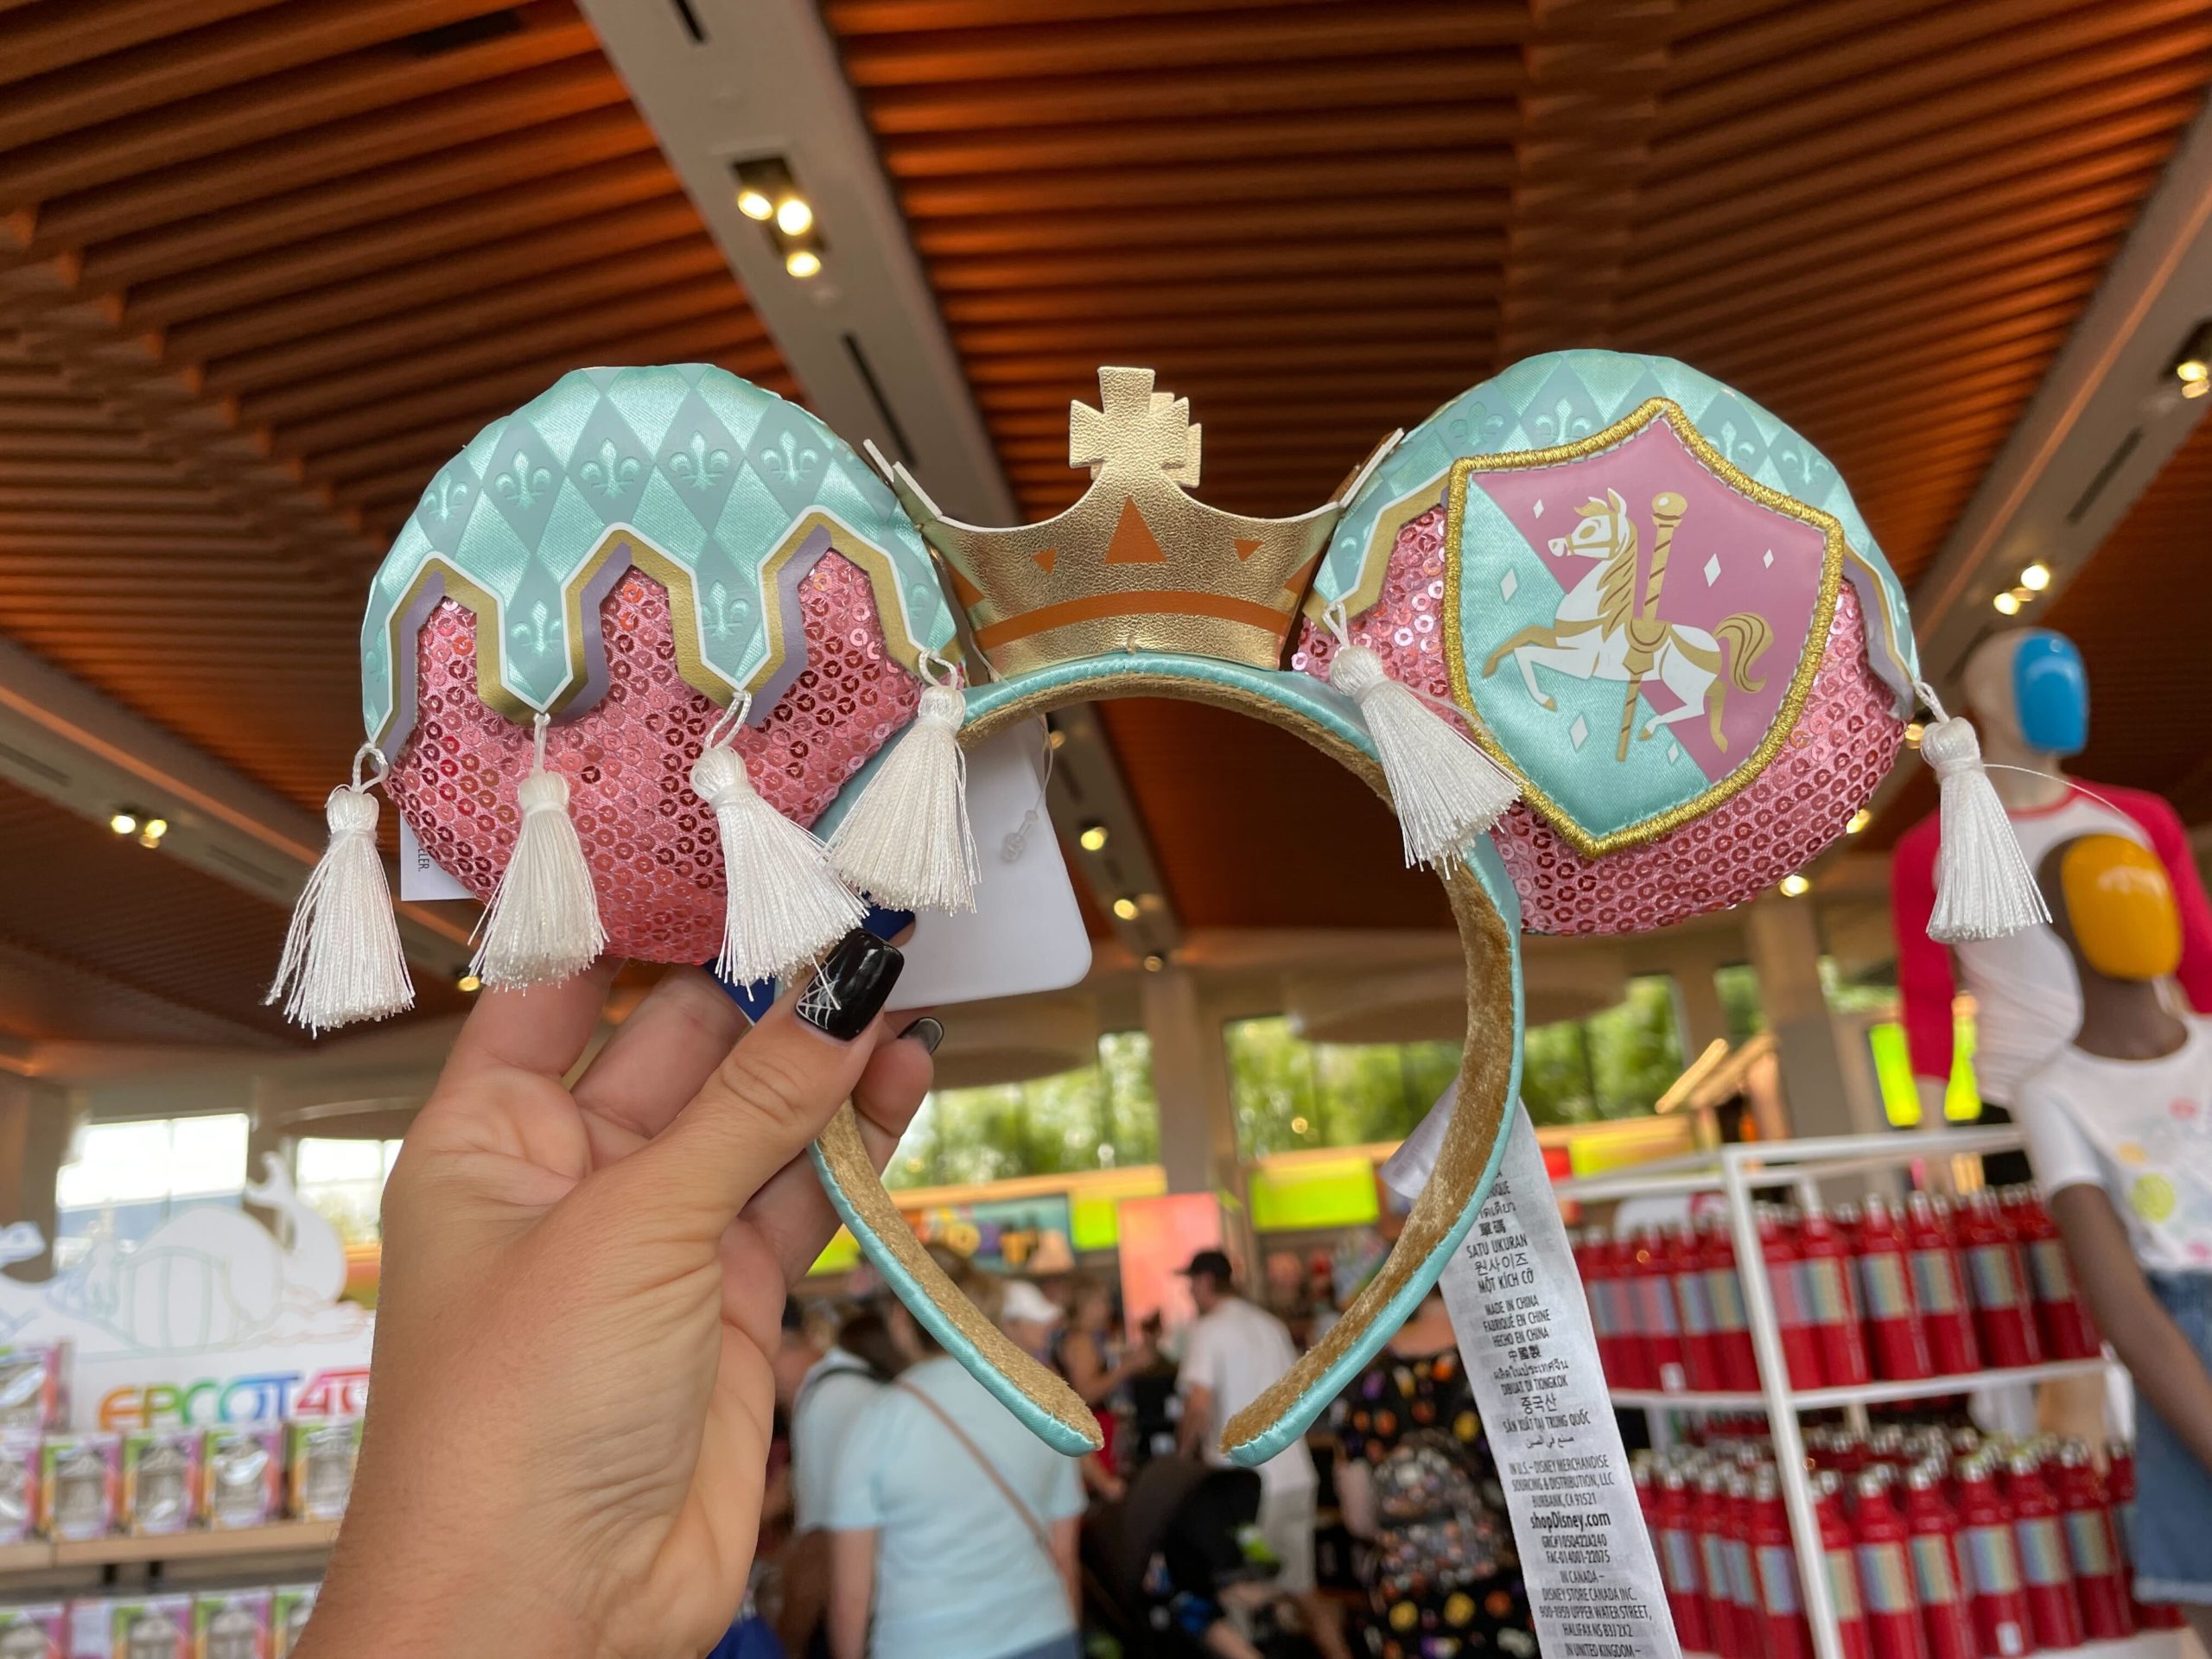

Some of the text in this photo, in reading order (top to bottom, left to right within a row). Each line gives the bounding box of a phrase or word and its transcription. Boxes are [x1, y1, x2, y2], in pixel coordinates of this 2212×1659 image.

[1466, 1233, 1529, 1259] SATU UKURAN
[1474, 1253, 1529, 1276] 원사이즈
[1484, 1294, 1539, 1316] MADE IN CHINA
[1483, 1308, 1552, 1333] FABRIQUÉ EN CHINE
[1491, 1325, 1549, 1348] HECHO EN CHINA
[1500, 1374, 1569, 1396] DIBUAT DI TIONGKOK
[1521, 1392, 1558, 1415] 중국산
[1544, 1414, 1569, 1430] TRUNG
[1508, 1462, 1517, 1476] IN
[1533, 1460, 1557, 1474] DISNEY
[1556, 1454, 1610, 1473] MERCHANDISE
[1511, 1471, 1615, 1492] SOURCING & DISTRIBUTION, LLC
[1531, 1492, 1598, 1509] BURBANK, CA 91521
[1530, 1510, 1611, 1534] shopDisney.com
[1559, 1570, 1569, 1584] IN
[1568, 1569, 1599, 1584] CANADA
[1541, 1586, 1637, 1601] DISNEY STORE CANADA INC.
[1569, 1605, 1595, 1619] UPPER
[1592, 1605, 1621, 1619] WATER
[1619, 1605, 1652, 1621] STREET,
[1561, 1623, 1593, 1637] HALIFAX
[1592, 1623, 1605, 1637] NS
[1617, 1623, 1634, 1637] 2X2
[1564, 1643, 1574, 1657] IN
[1573, 1643, 1599, 1657] UNITED
[1597, 1643, 1636, 1657] KINGDOM
